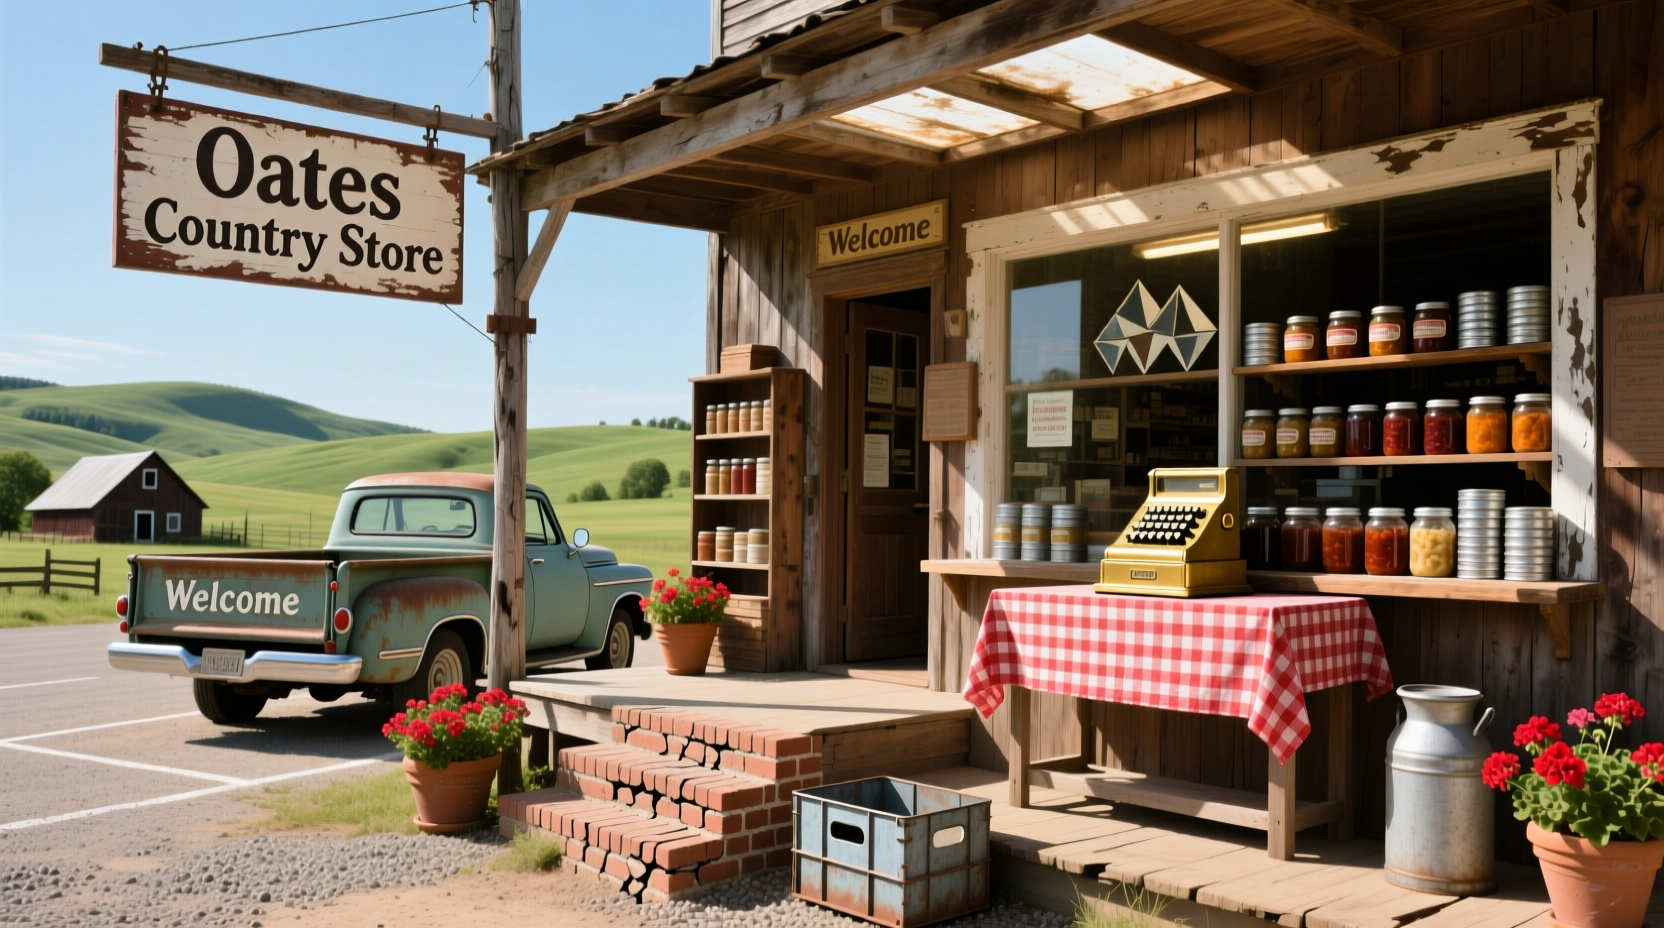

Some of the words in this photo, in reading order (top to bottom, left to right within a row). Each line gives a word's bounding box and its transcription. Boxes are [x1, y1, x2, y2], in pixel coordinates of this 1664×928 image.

[196, 126, 401, 220] Oates
[144, 197, 328, 272] Country
[339, 223, 444, 275] Store
[828, 219, 931, 256] Welcome
[165, 579, 300, 616] Welcome
